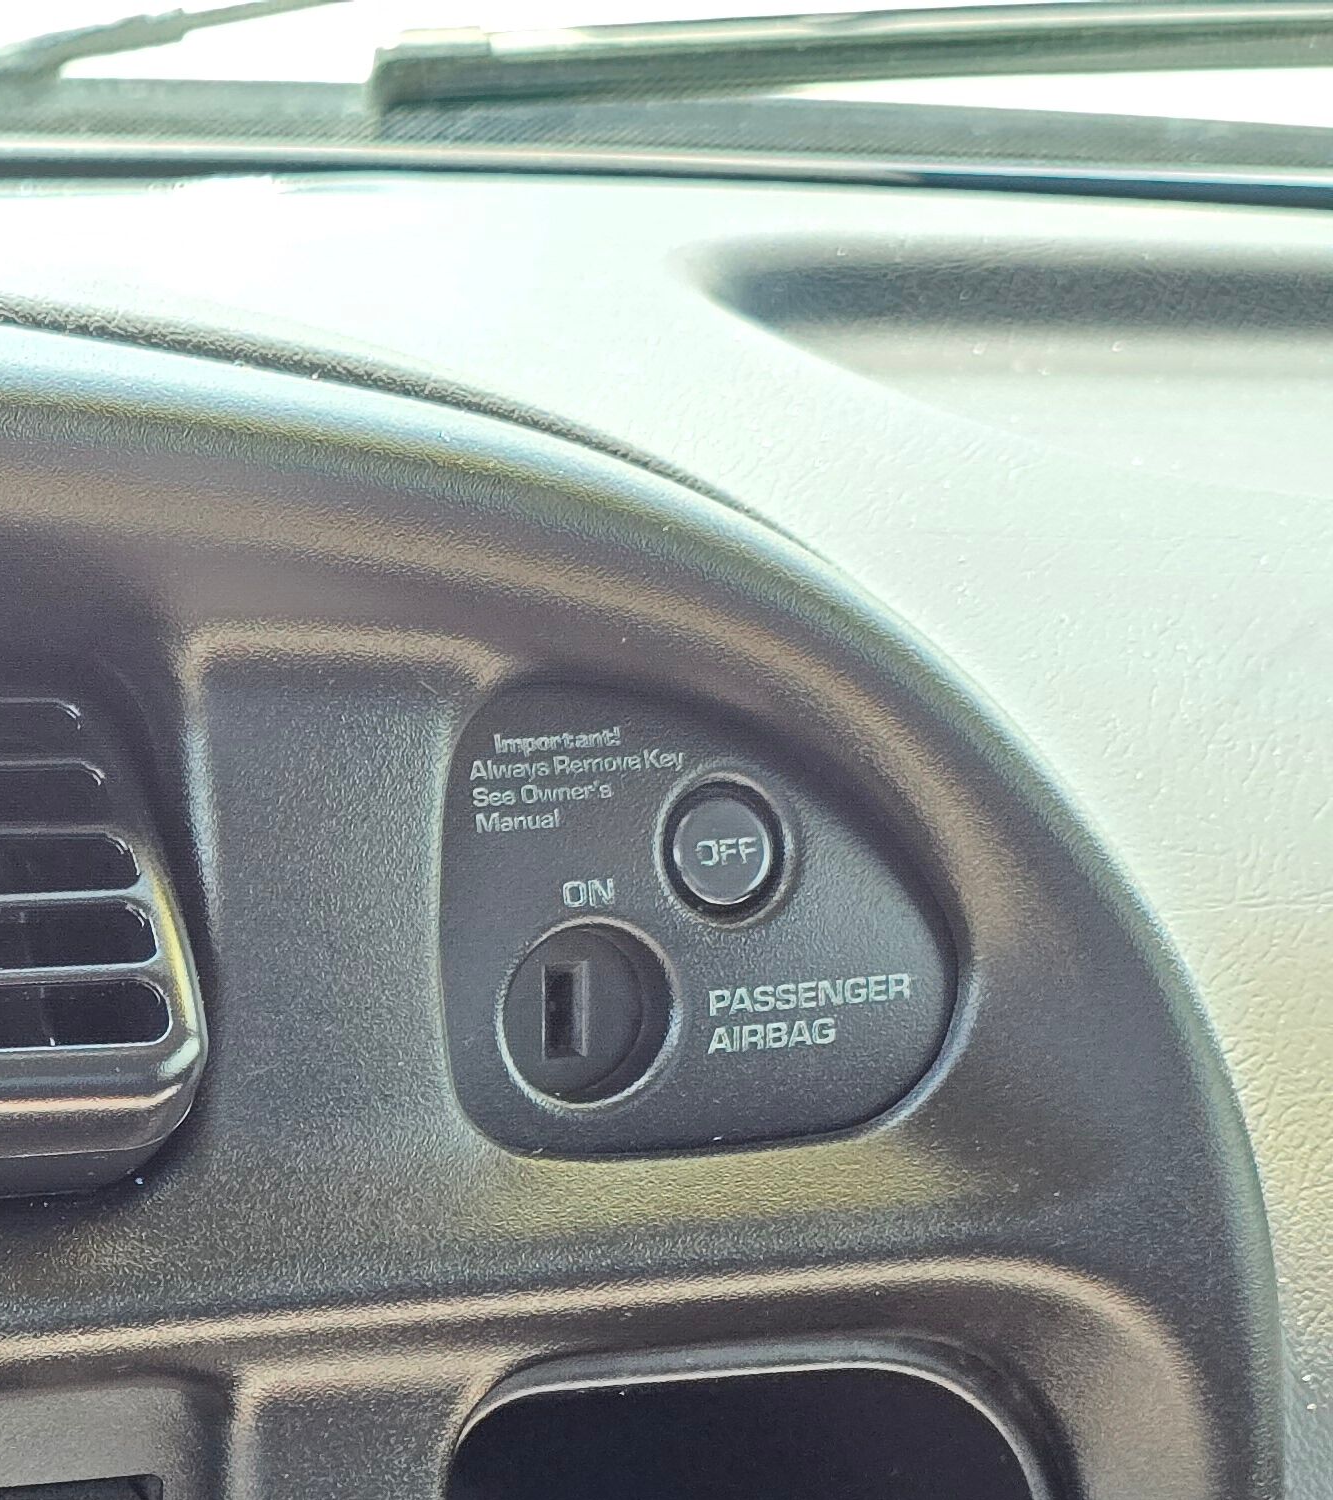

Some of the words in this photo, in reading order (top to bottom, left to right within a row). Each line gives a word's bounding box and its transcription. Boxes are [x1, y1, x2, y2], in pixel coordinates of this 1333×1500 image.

[494, 727, 621, 756] Important!
[470, 760, 549, 781] Always
[553, 755, 641, 775] Remove
[643, 749, 684, 771] Key
[473, 787, 516, 807] See
[521, 781, 612, 804] Owner's
[475, 808, 560, 833] Manual
[696, 837, 756, 866] OFF
[563, 878, 614, 908] ON
[708, 974, 910, 1016] PASSENGER
[708, 1018, 836, 1054] AIRBAG
